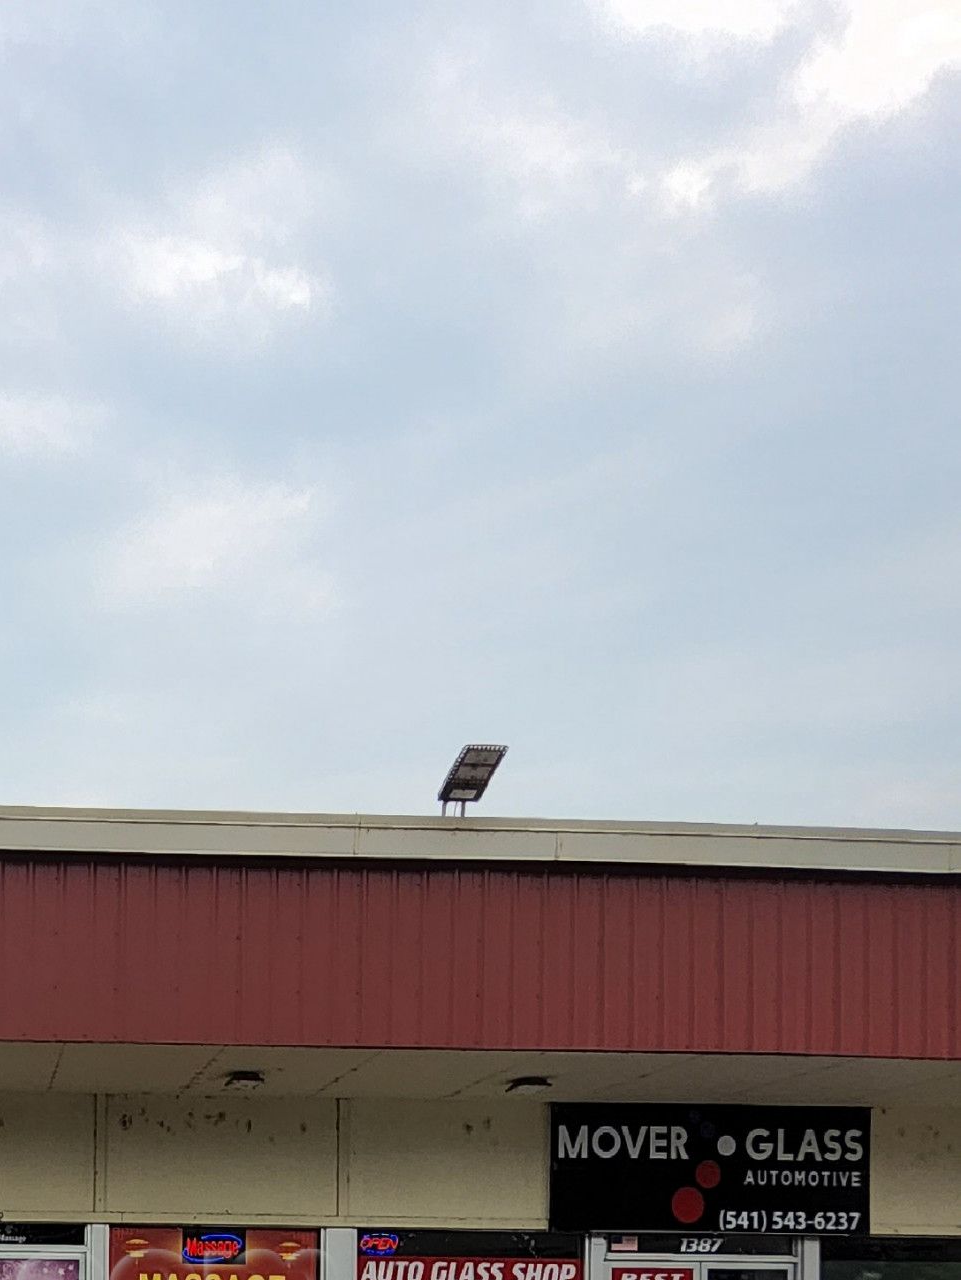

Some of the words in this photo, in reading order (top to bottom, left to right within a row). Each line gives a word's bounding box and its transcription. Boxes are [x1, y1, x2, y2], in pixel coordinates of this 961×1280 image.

[557, 1124, 690, 1160] MOVER
[745, 1128, 864, 1162] GLASS
[743, 1169, 862, 1187] AUTOMOTIVE
[719, 1209, 768, 1232] (541)
[771, 1211, 862, 1231] 543-6237
[186, 1237, 240, 1259] Massage
[360, 1236, 398, 1251] OPEN
[680, 1238, 724, 1253] 1387
